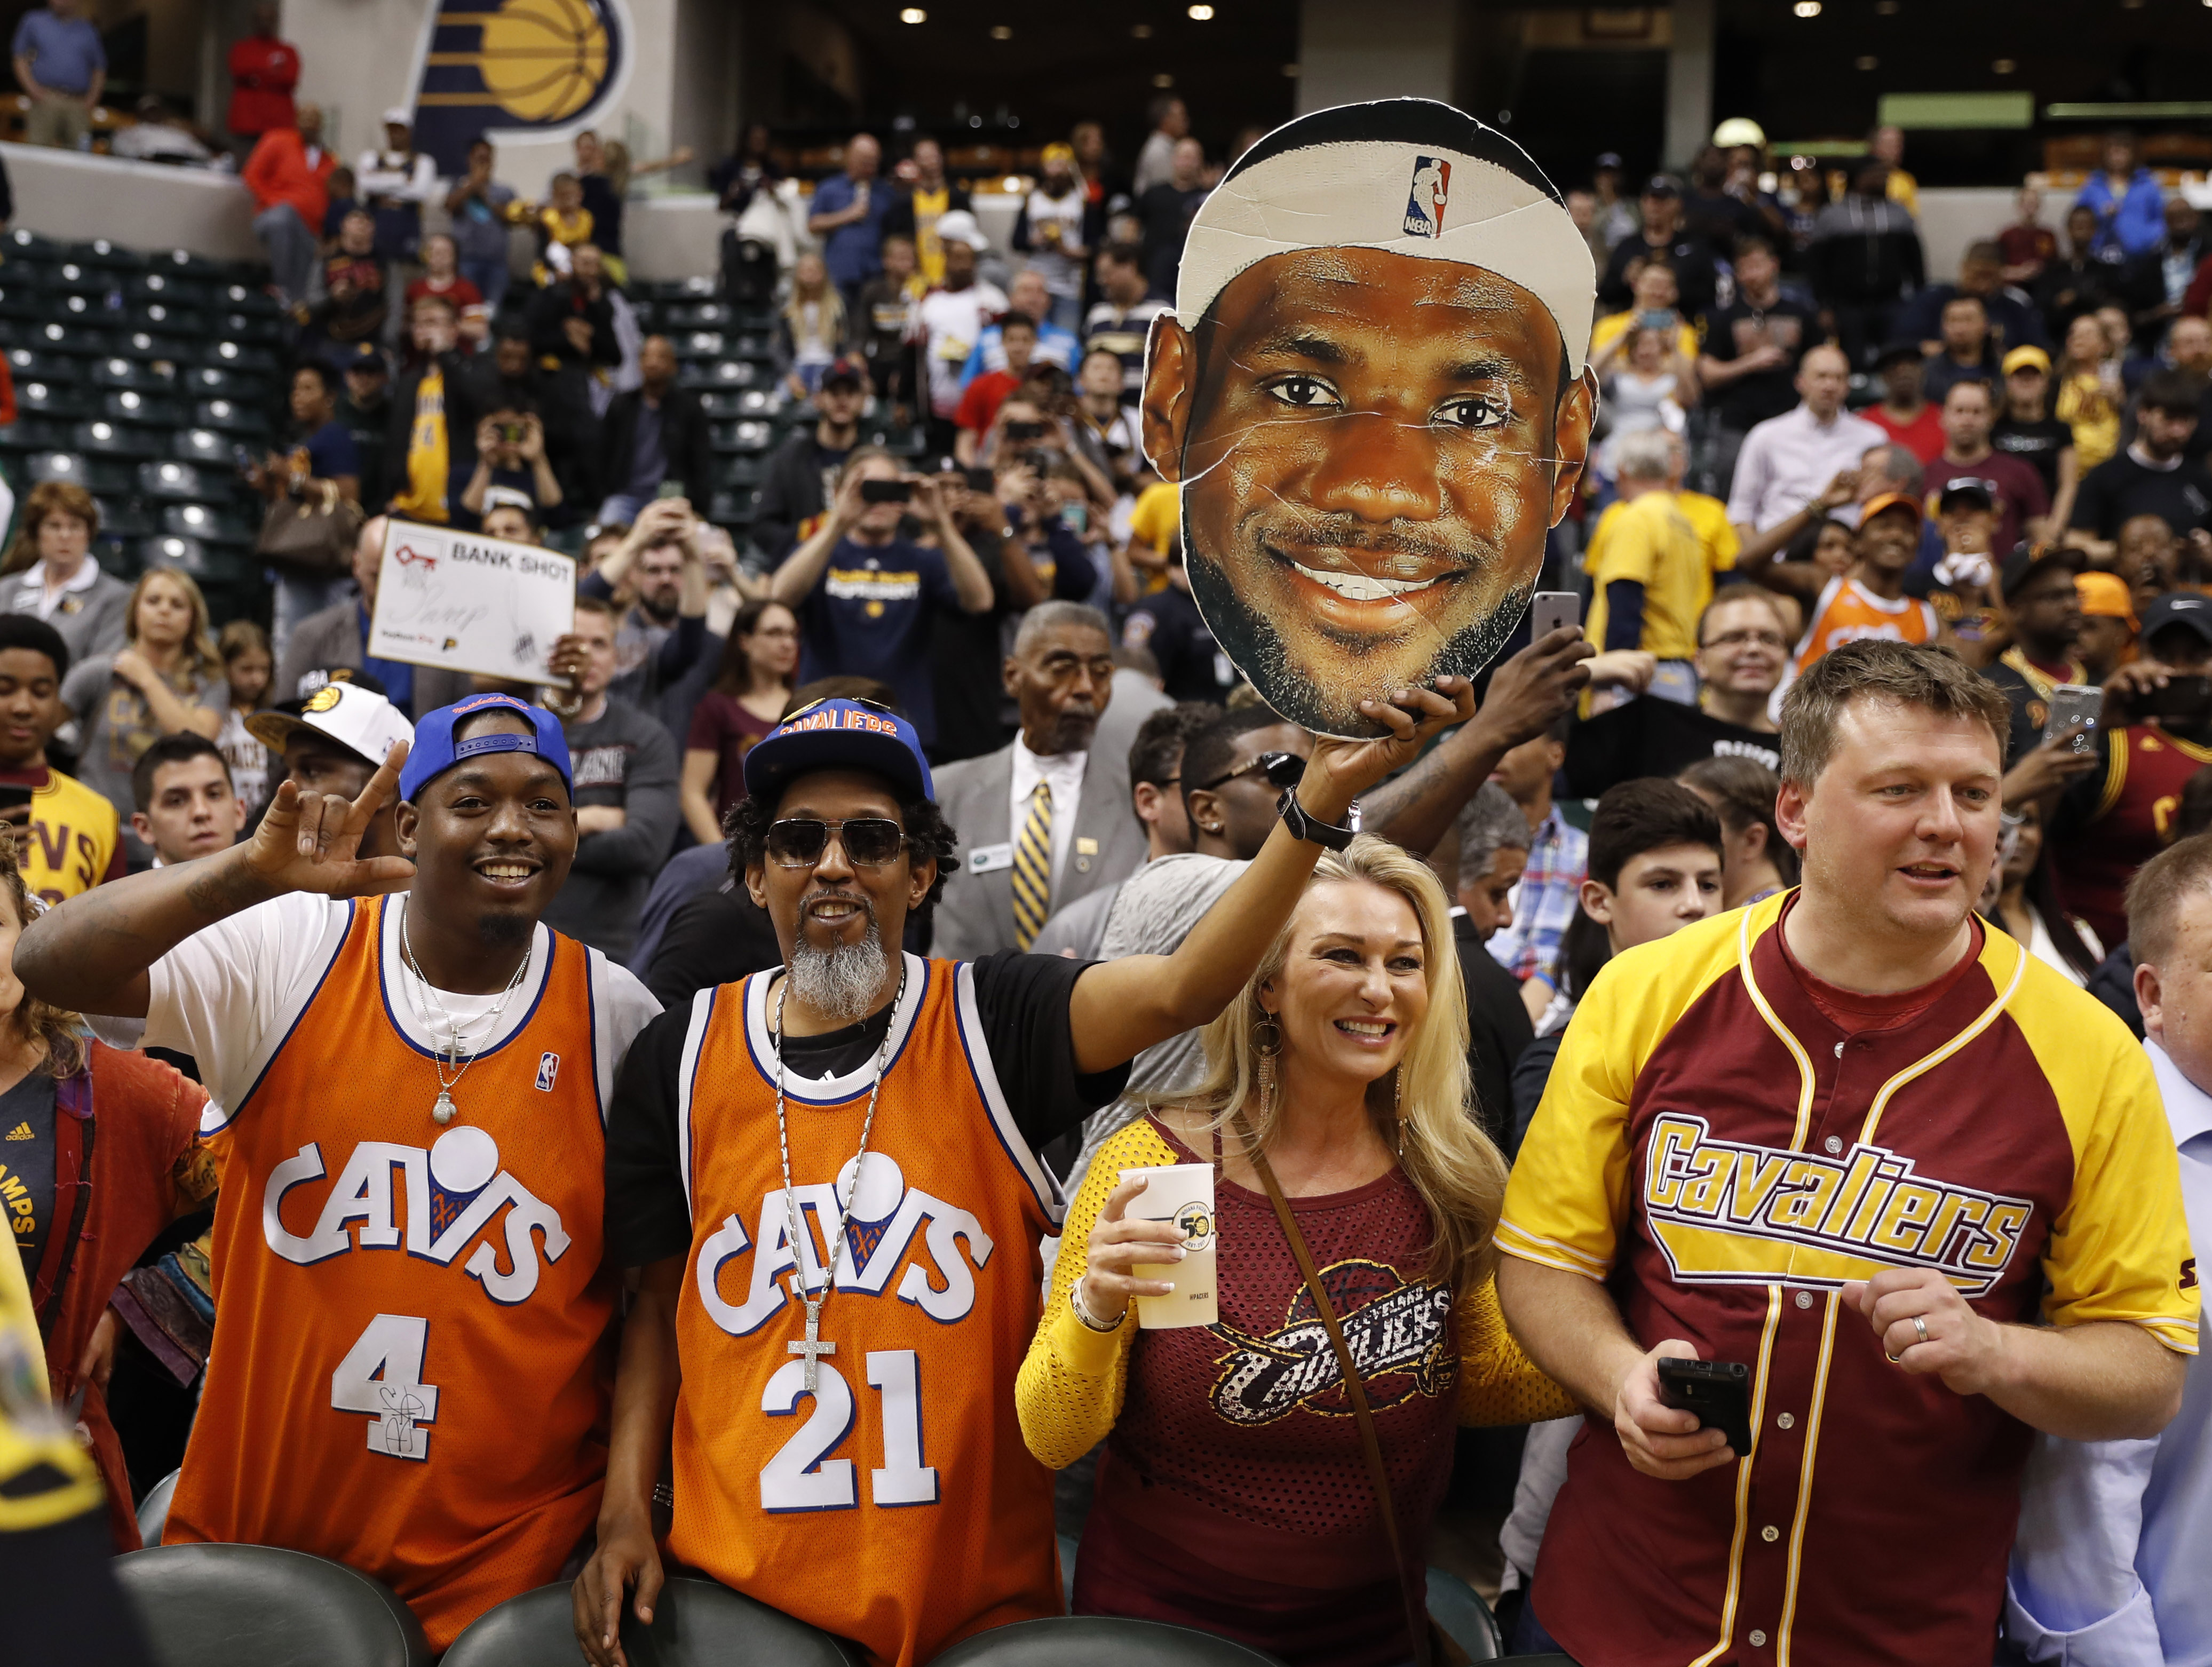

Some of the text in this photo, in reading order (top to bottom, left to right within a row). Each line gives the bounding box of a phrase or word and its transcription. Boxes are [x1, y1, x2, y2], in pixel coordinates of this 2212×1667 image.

[1405, 216, 1432, 235] NBA
[452, 541, 569, 583] BANK SHOT
[780, 709, 898, 737] CAVALIERS
[18, 820, 98, 889] VS
[537, 1080, 548, 1089] NBA
[5, 1133, 35, 1141] adidas
[263, 1131, 572, 1306] CAVS
[1644, 1112, 2034, 1273] Cavaliers
[696, 1174, 994, 1337] CAVS
[1343, 1285, 1424, 1336] CLEVELAND
[331, 1313, 440, 1463] 4
[759, 1350, 941, 1514] 21
